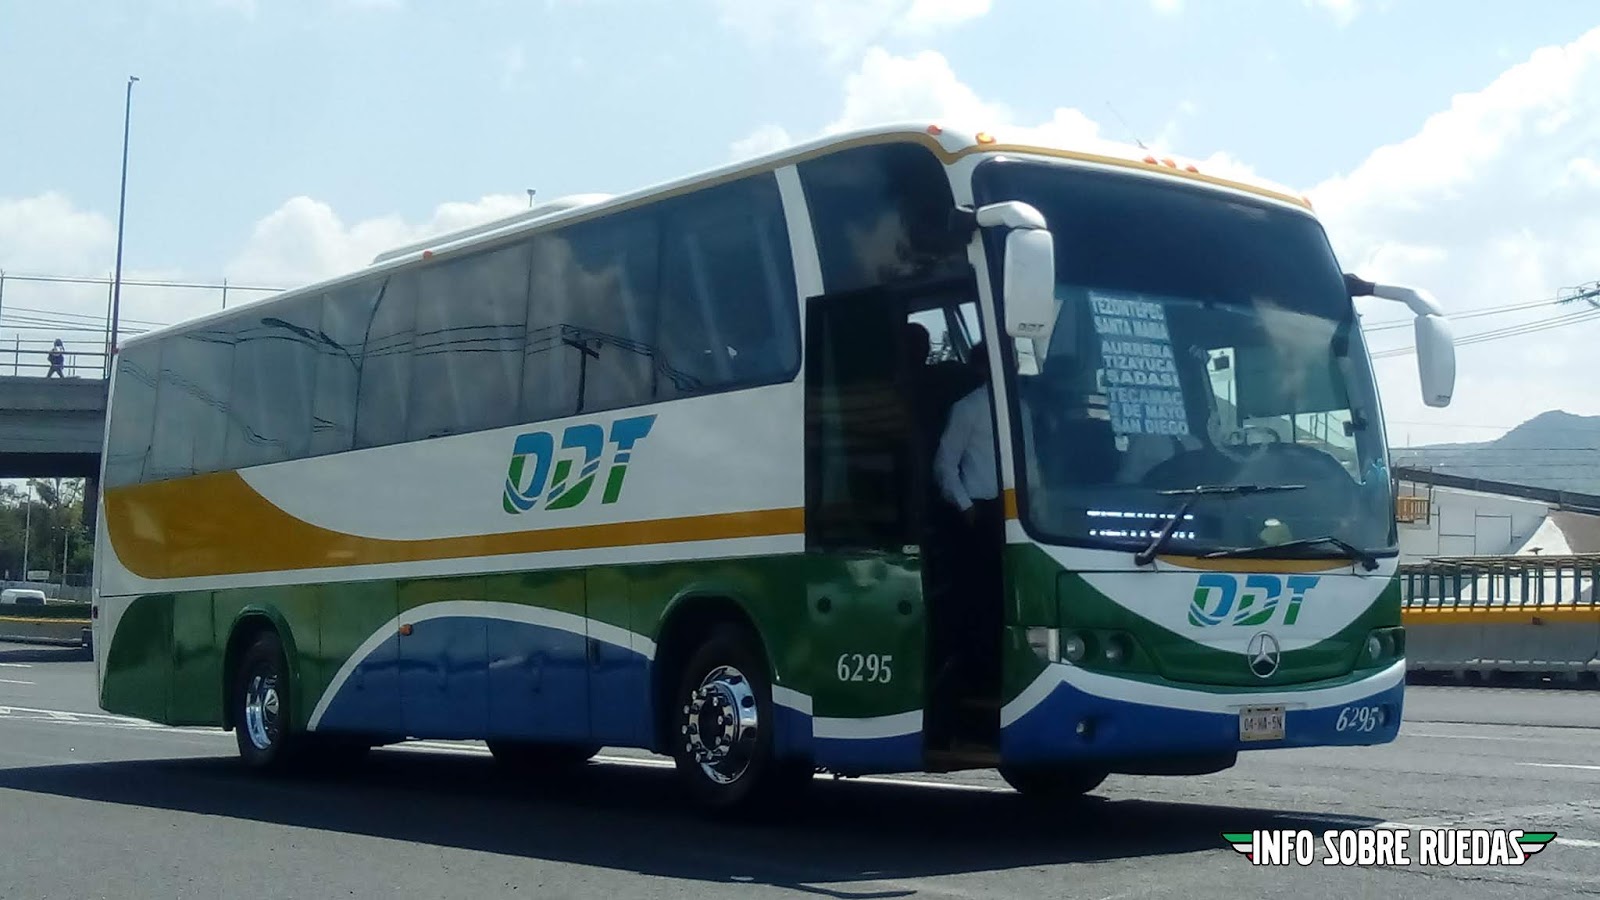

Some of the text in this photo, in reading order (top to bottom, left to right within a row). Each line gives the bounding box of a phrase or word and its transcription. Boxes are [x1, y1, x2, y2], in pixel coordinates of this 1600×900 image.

[1103, 355, 1177, 372] TIZAYUCA
[1106, 369, 1180, 387] SADASI
[1122, 403, 1141, 418] DE
[1145, 404, 1187, 420] MAYO
[1112, 418, 1189, 435] SAN DIEGO
[502, 414, 658, 515] ODT
[1187, 573, 1321, 627] ODT
[837, 653, 893, 683] 6295
[1336, 706, 1379, 732] 6295
